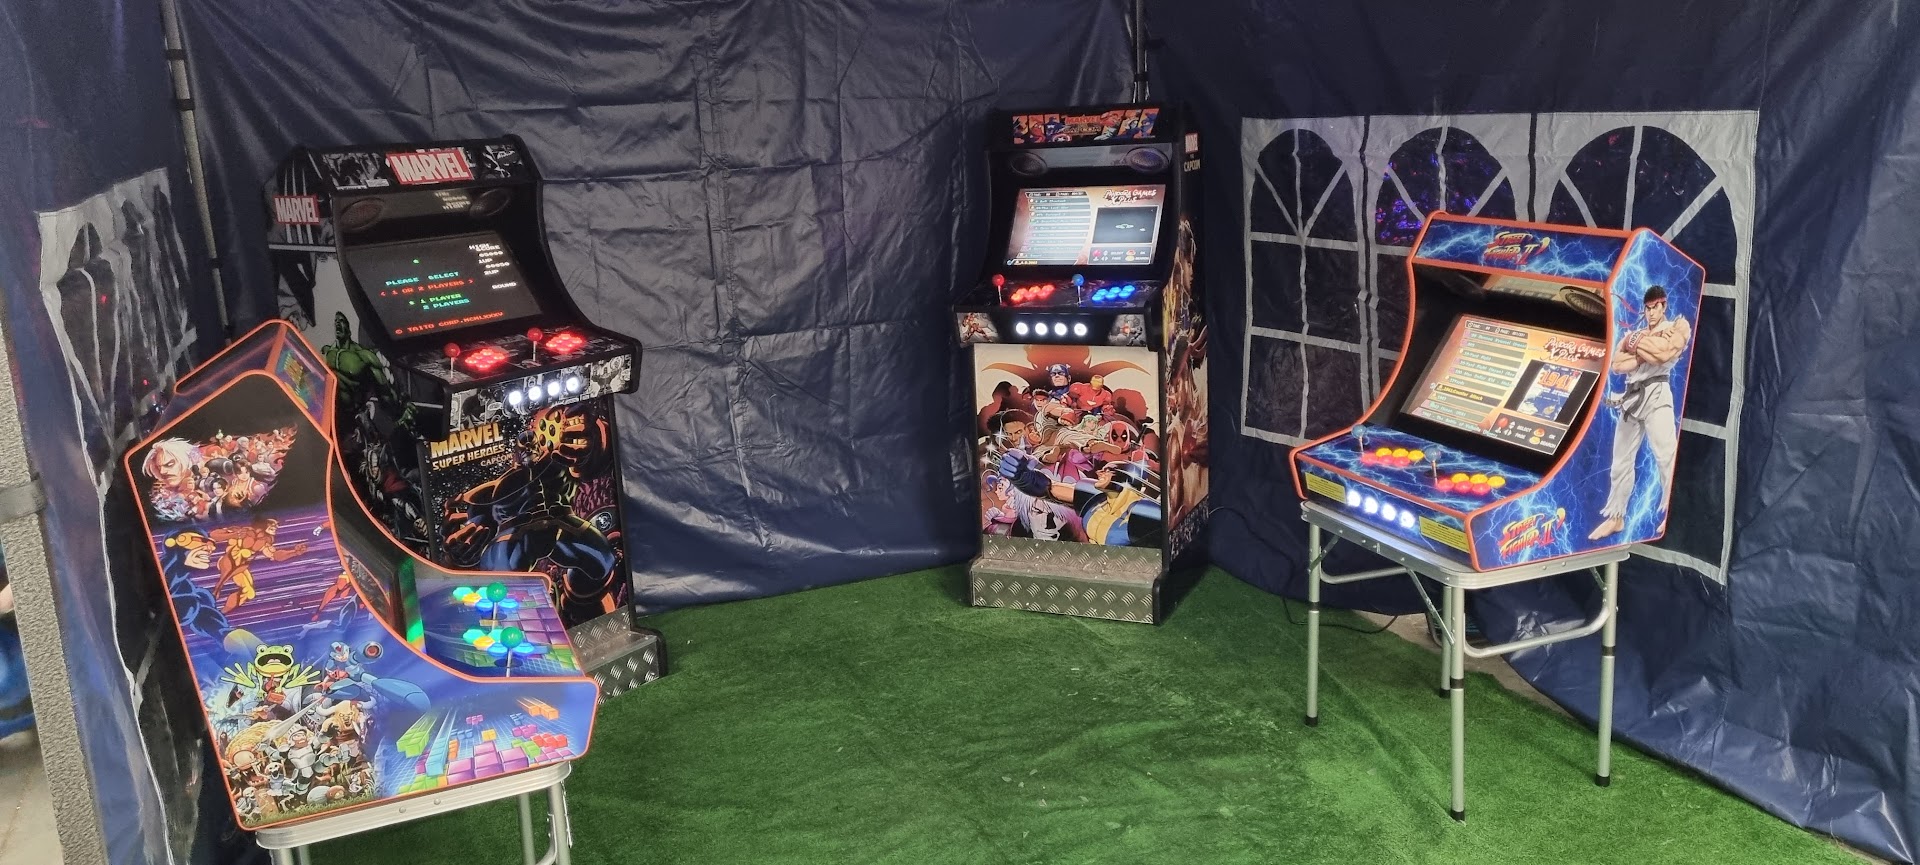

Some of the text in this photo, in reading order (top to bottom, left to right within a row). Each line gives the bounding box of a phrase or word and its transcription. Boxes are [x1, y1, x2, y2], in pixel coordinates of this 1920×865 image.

[390, 152, 469, 183] MARVEL
[274, 197, 319, 223] MARVEL
[1487, 231, 1533, 249] STREET
[1484, 244, 1522, 261] FIGHTER
[385, 271, 459, 286] PLEASE SELECT
[427, 280, 465, 290] PLAYERS
[491, 281, 517, 290] ROUND
[429, 293, 462, 303] PLAYER
[433, 298, 470, 309] PLAYERS
[407, 323, 435, 333] TAITO
[1556, 348, 1581, 362] PLUS
[1577, 343, 1606, 358] GAMES
[1537, 370, 1574, 391] 1941
[430, 422, 504, 459] MARVEL
[432, 444, 505, 471] SUPER HEROES
[480, 453, 513, 467] CAPCOM
[1497, 513, 1545, 546] STREET
[1500, 528, 1542, 559] FIGHTER
